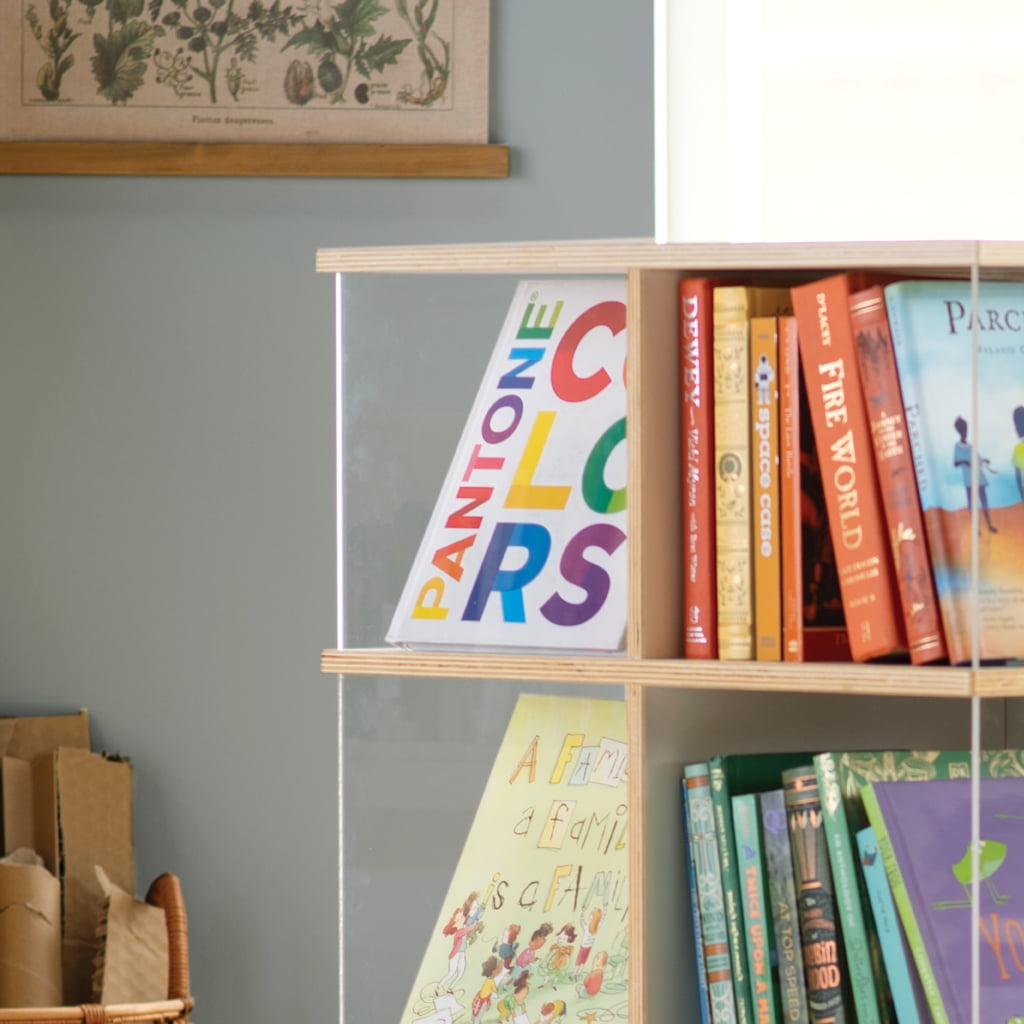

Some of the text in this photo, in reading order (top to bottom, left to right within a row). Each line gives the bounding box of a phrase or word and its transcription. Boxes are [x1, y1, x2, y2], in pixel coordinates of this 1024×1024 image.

[551, 300, 627, 403] C
[682, 296, 700, 408] DEWEY
[818, 358, 848, 427] FIRE
[411, 300, 564, 620] PANTONE
[755, 408, 773, 557] space case
[830, 430, 863, 550] WORLD
[461, 522, 627, 627] RS
[509, 735, 540, 784] A
[513, 806, 535, 838] a
[519, 880, 540, 912] a
[744, 866, 760, 919] TWICE
[750, 924, 765, 975] UPON
[755, 980, 766, 993] A
[779, 902, 800, 1022] AT TOP SPEED
